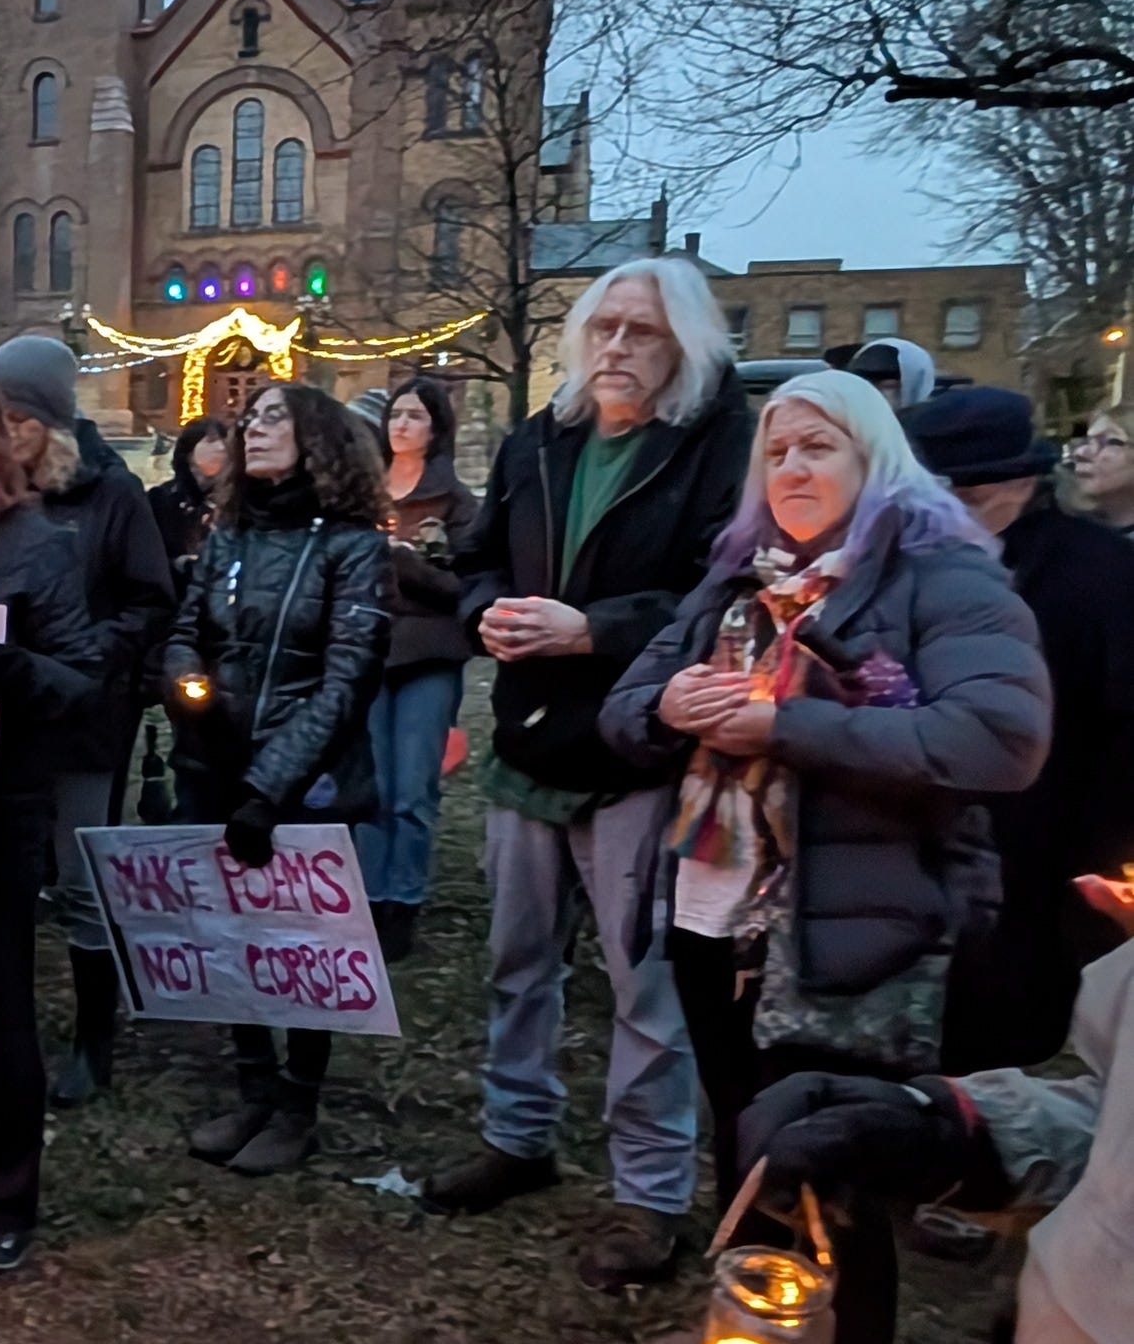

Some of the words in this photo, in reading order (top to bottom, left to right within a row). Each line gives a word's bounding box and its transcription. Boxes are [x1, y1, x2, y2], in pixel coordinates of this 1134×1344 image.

[108, 855, 214, 913] MAKE
[214, 846, 351, 915] POEMS
[137, 942, 215, 996] NOT
[246, 943, 378, 1011] CORPSES
